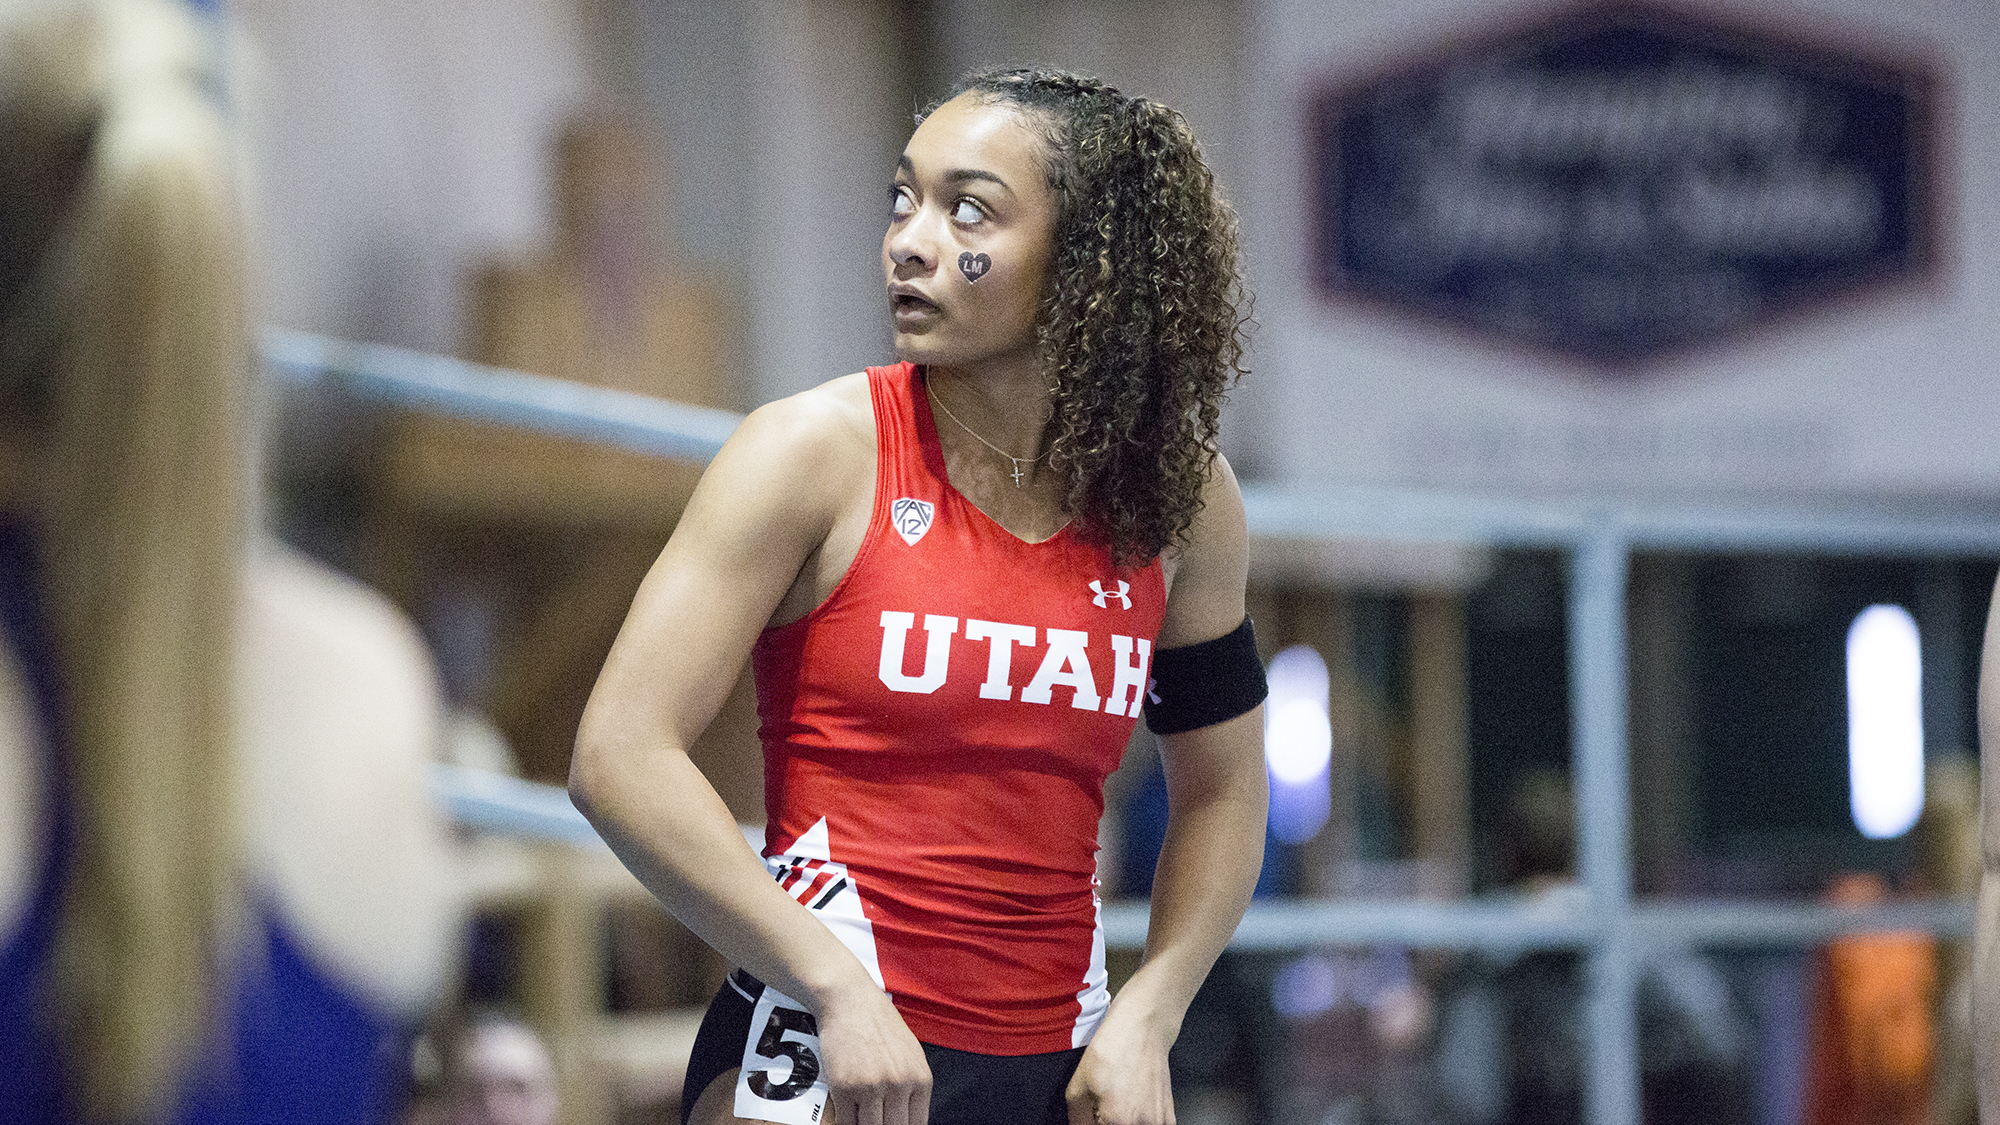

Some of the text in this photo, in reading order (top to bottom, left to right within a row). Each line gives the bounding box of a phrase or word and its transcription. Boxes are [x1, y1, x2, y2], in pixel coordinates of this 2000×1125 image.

[963, 260, 983, 274] LM
[894, 500, 931, 527] PAC
[902, 519, 921, 535] 12
[878, 610, 1151, 718] UTAH
[747, 1006, 820, 1101] 5
[811, 1103, 821, 1122] GILL
